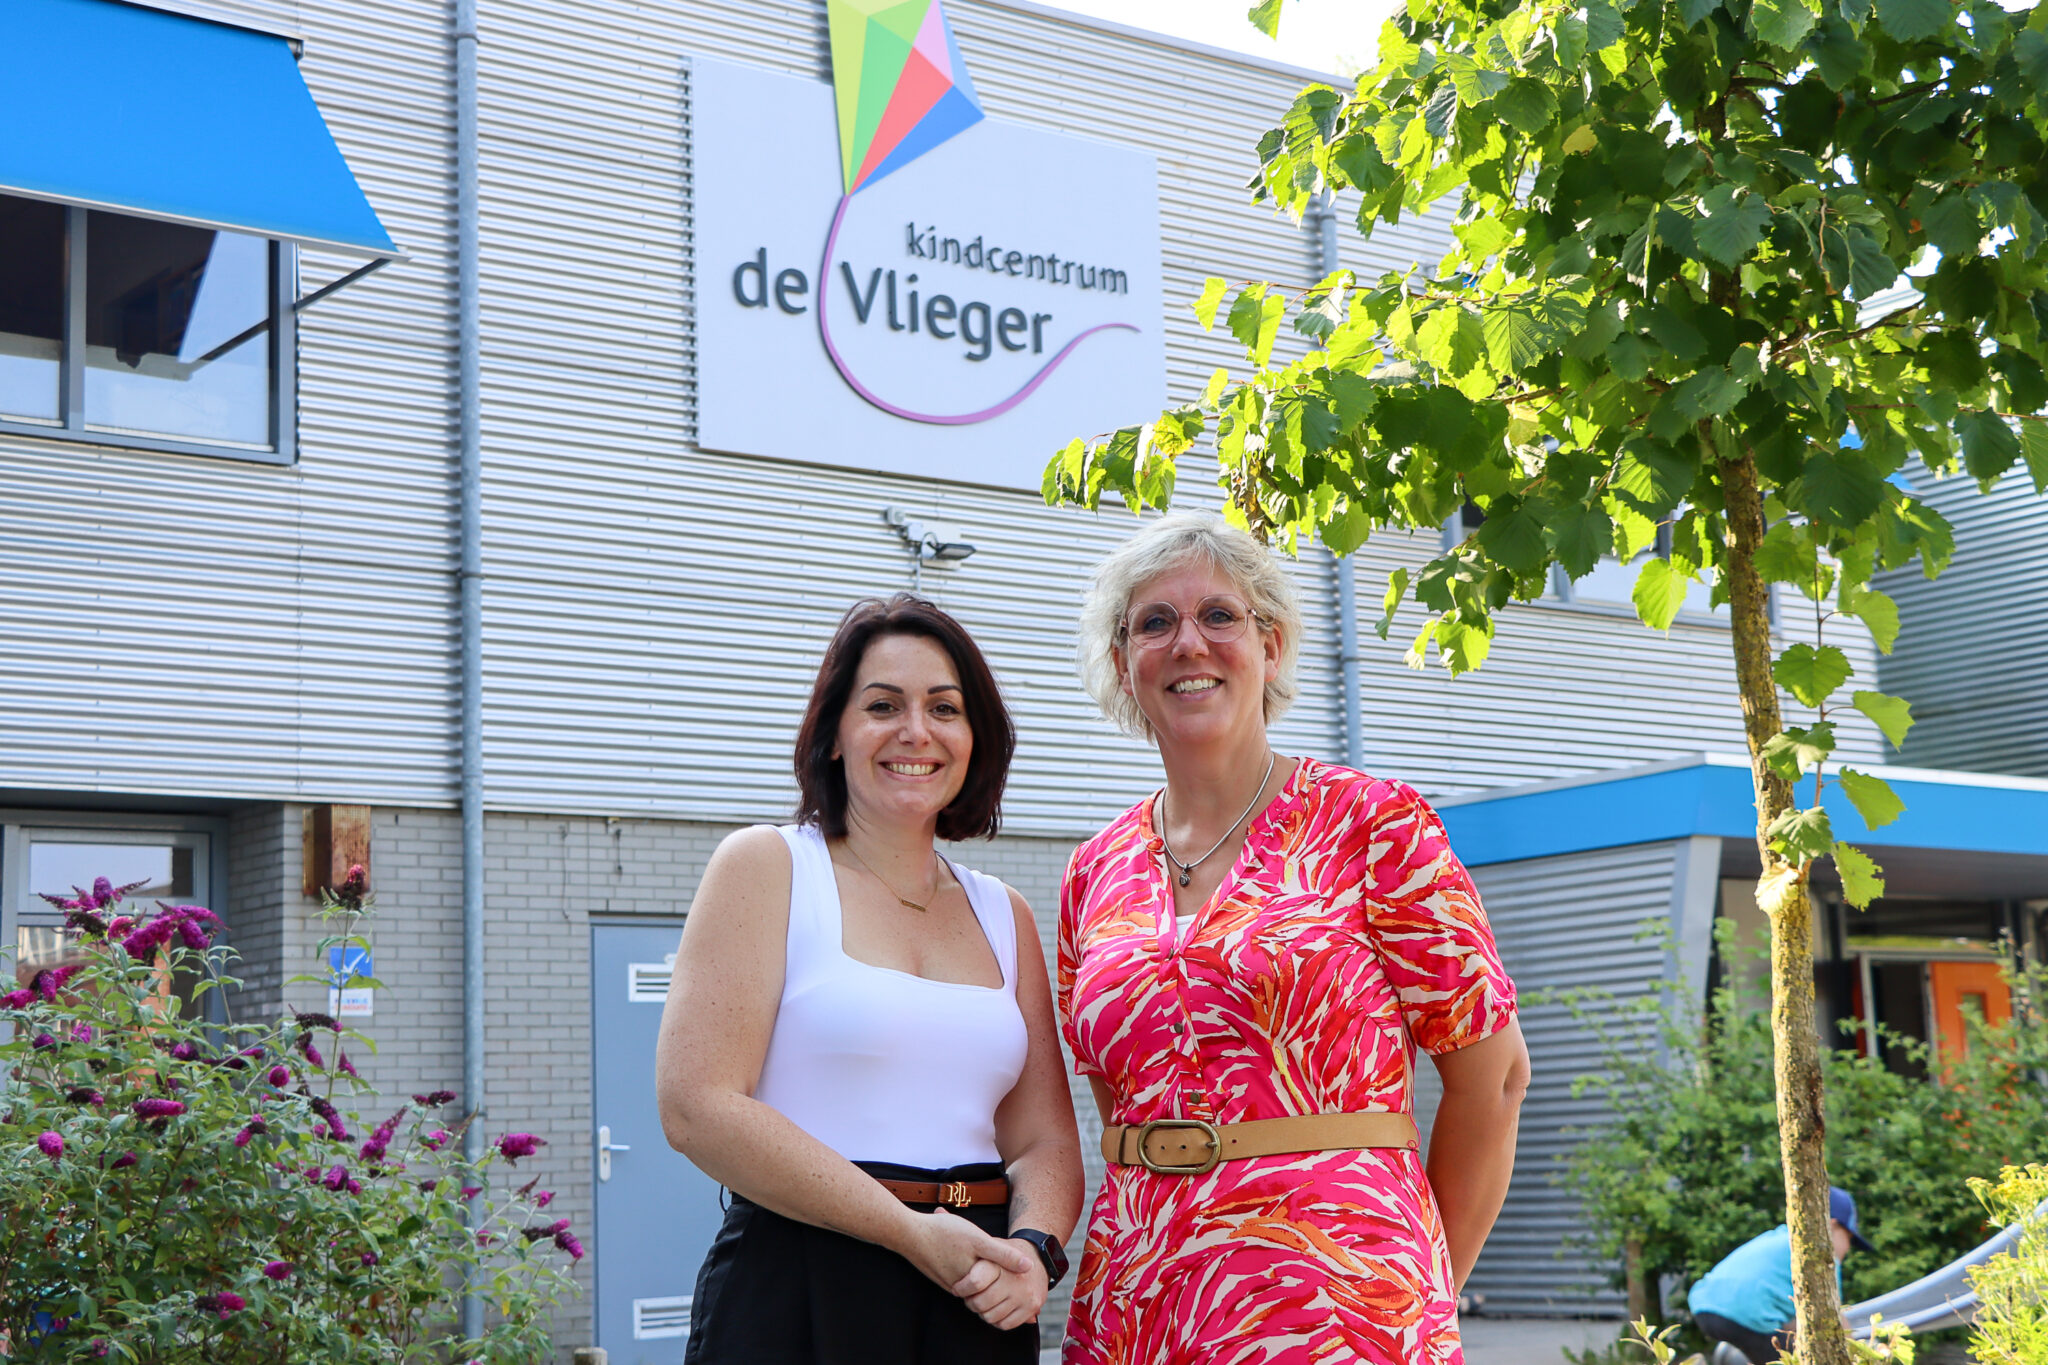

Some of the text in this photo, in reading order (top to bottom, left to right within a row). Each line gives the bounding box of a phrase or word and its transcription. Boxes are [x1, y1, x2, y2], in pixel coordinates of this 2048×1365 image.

[733, 247, 1053, 361] de Vlieger
[907, 222, 1128, 294] kindcentrum
